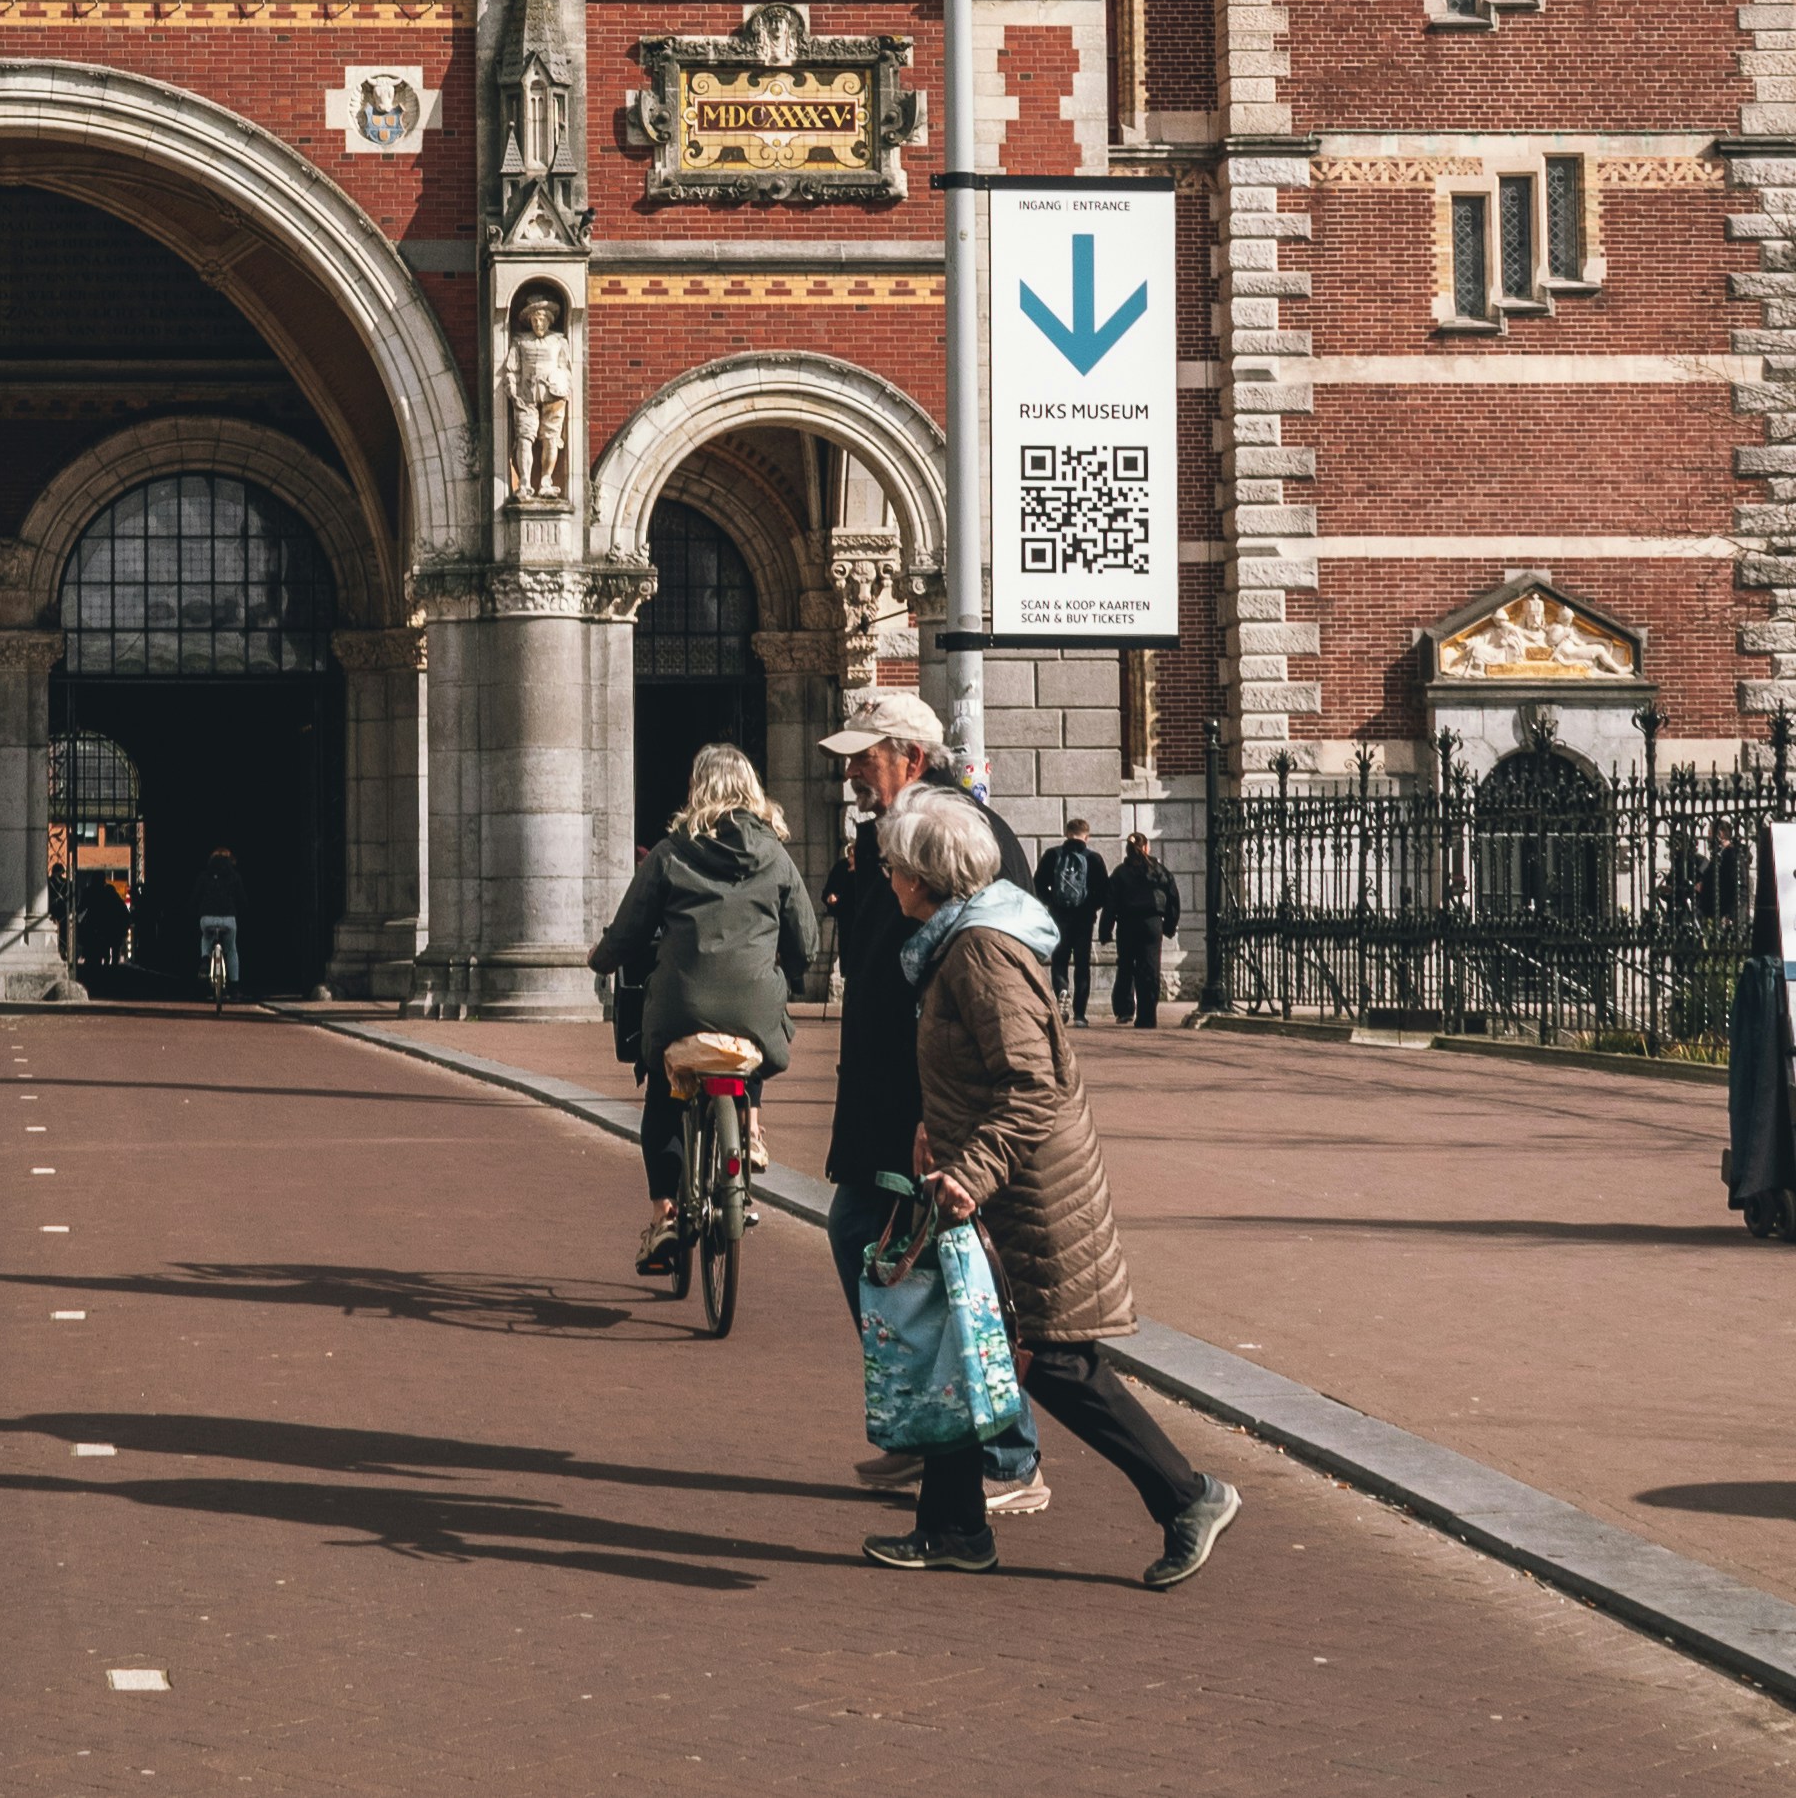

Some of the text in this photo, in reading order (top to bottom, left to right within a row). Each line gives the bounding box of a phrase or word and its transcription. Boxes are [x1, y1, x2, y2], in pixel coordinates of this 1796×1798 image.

[1019, 200, 1130, 212] INGANG ENTRANCE
[1019, 403, 1149, 420] RIJKS MUSEUM
[1021, 600, 1150, 611] SCAN & KOOP KAARTEN
[1021, 613, 1135, 624] SCAN & BUY TICKETS
